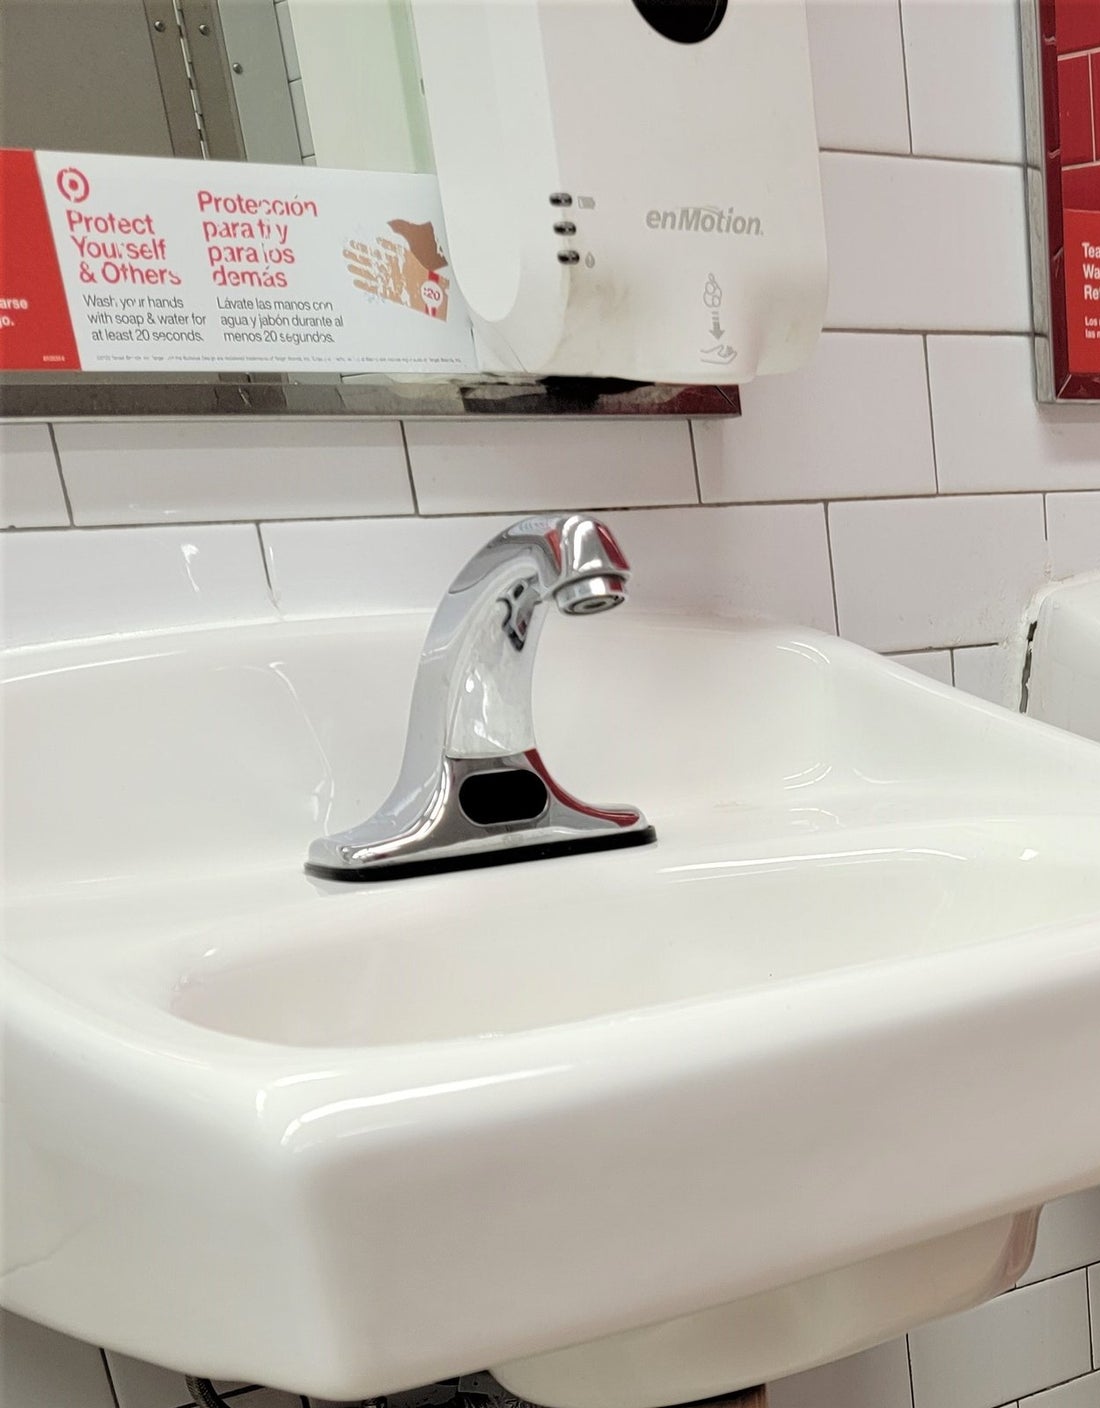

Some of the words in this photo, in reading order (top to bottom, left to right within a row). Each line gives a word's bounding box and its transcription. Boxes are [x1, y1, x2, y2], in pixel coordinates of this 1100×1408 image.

[198, 191, 318, 217] Protección
[66, 210, 155, 235] Protect
[202, 219, 254, 242] para
[257, 218, 273, 239] ti
[275, 223, 288, 244] y
[646, 207, 765, 236] enMotion
[70, 235, 166, 260] Yourself
[207, 245, 260, 266] para
[262, 243, 296, 265] los
[79, 261, 98, 284] &
[101, 262, 182, 285] Others
[212, 264, 288, 288] demás
[83, 294, 115, 309] Wash
[120, 297, 146, 311] your
[147, 296, 184, 309] hands
[216, 297, 254, 310] Lávate
[255, 297, 272, 310] las
[274, 301, 311, 311] manos
[313, 301, 333, 312] con
[88, 313, 113, 325] with
[114, 314, 144, 328] soap
[146, 313, 156, 325] &
[157, 314, 189, 325] water
[191, 313, 207, 325] for
[221, 315, 249, 328] agua
[250, 317, 257, 330] y
[257, 313, 291, 329] jabón
[293, 315, 333, 327] durante
[335, 315, 344, 327] al
[1085, 316, 1097, 327] Los
[91, 330, 104, 341] at
[105, 329, 134, 341] least
[135, 329, 151, 341] 20
[152, 329, 204, 342] seconds.
[224, 332, 262, 342] menos
[264, 331, 278, 343] 20
[280, 332, 335, 345] segundos.
[1085, 329, 1096, 339] las
